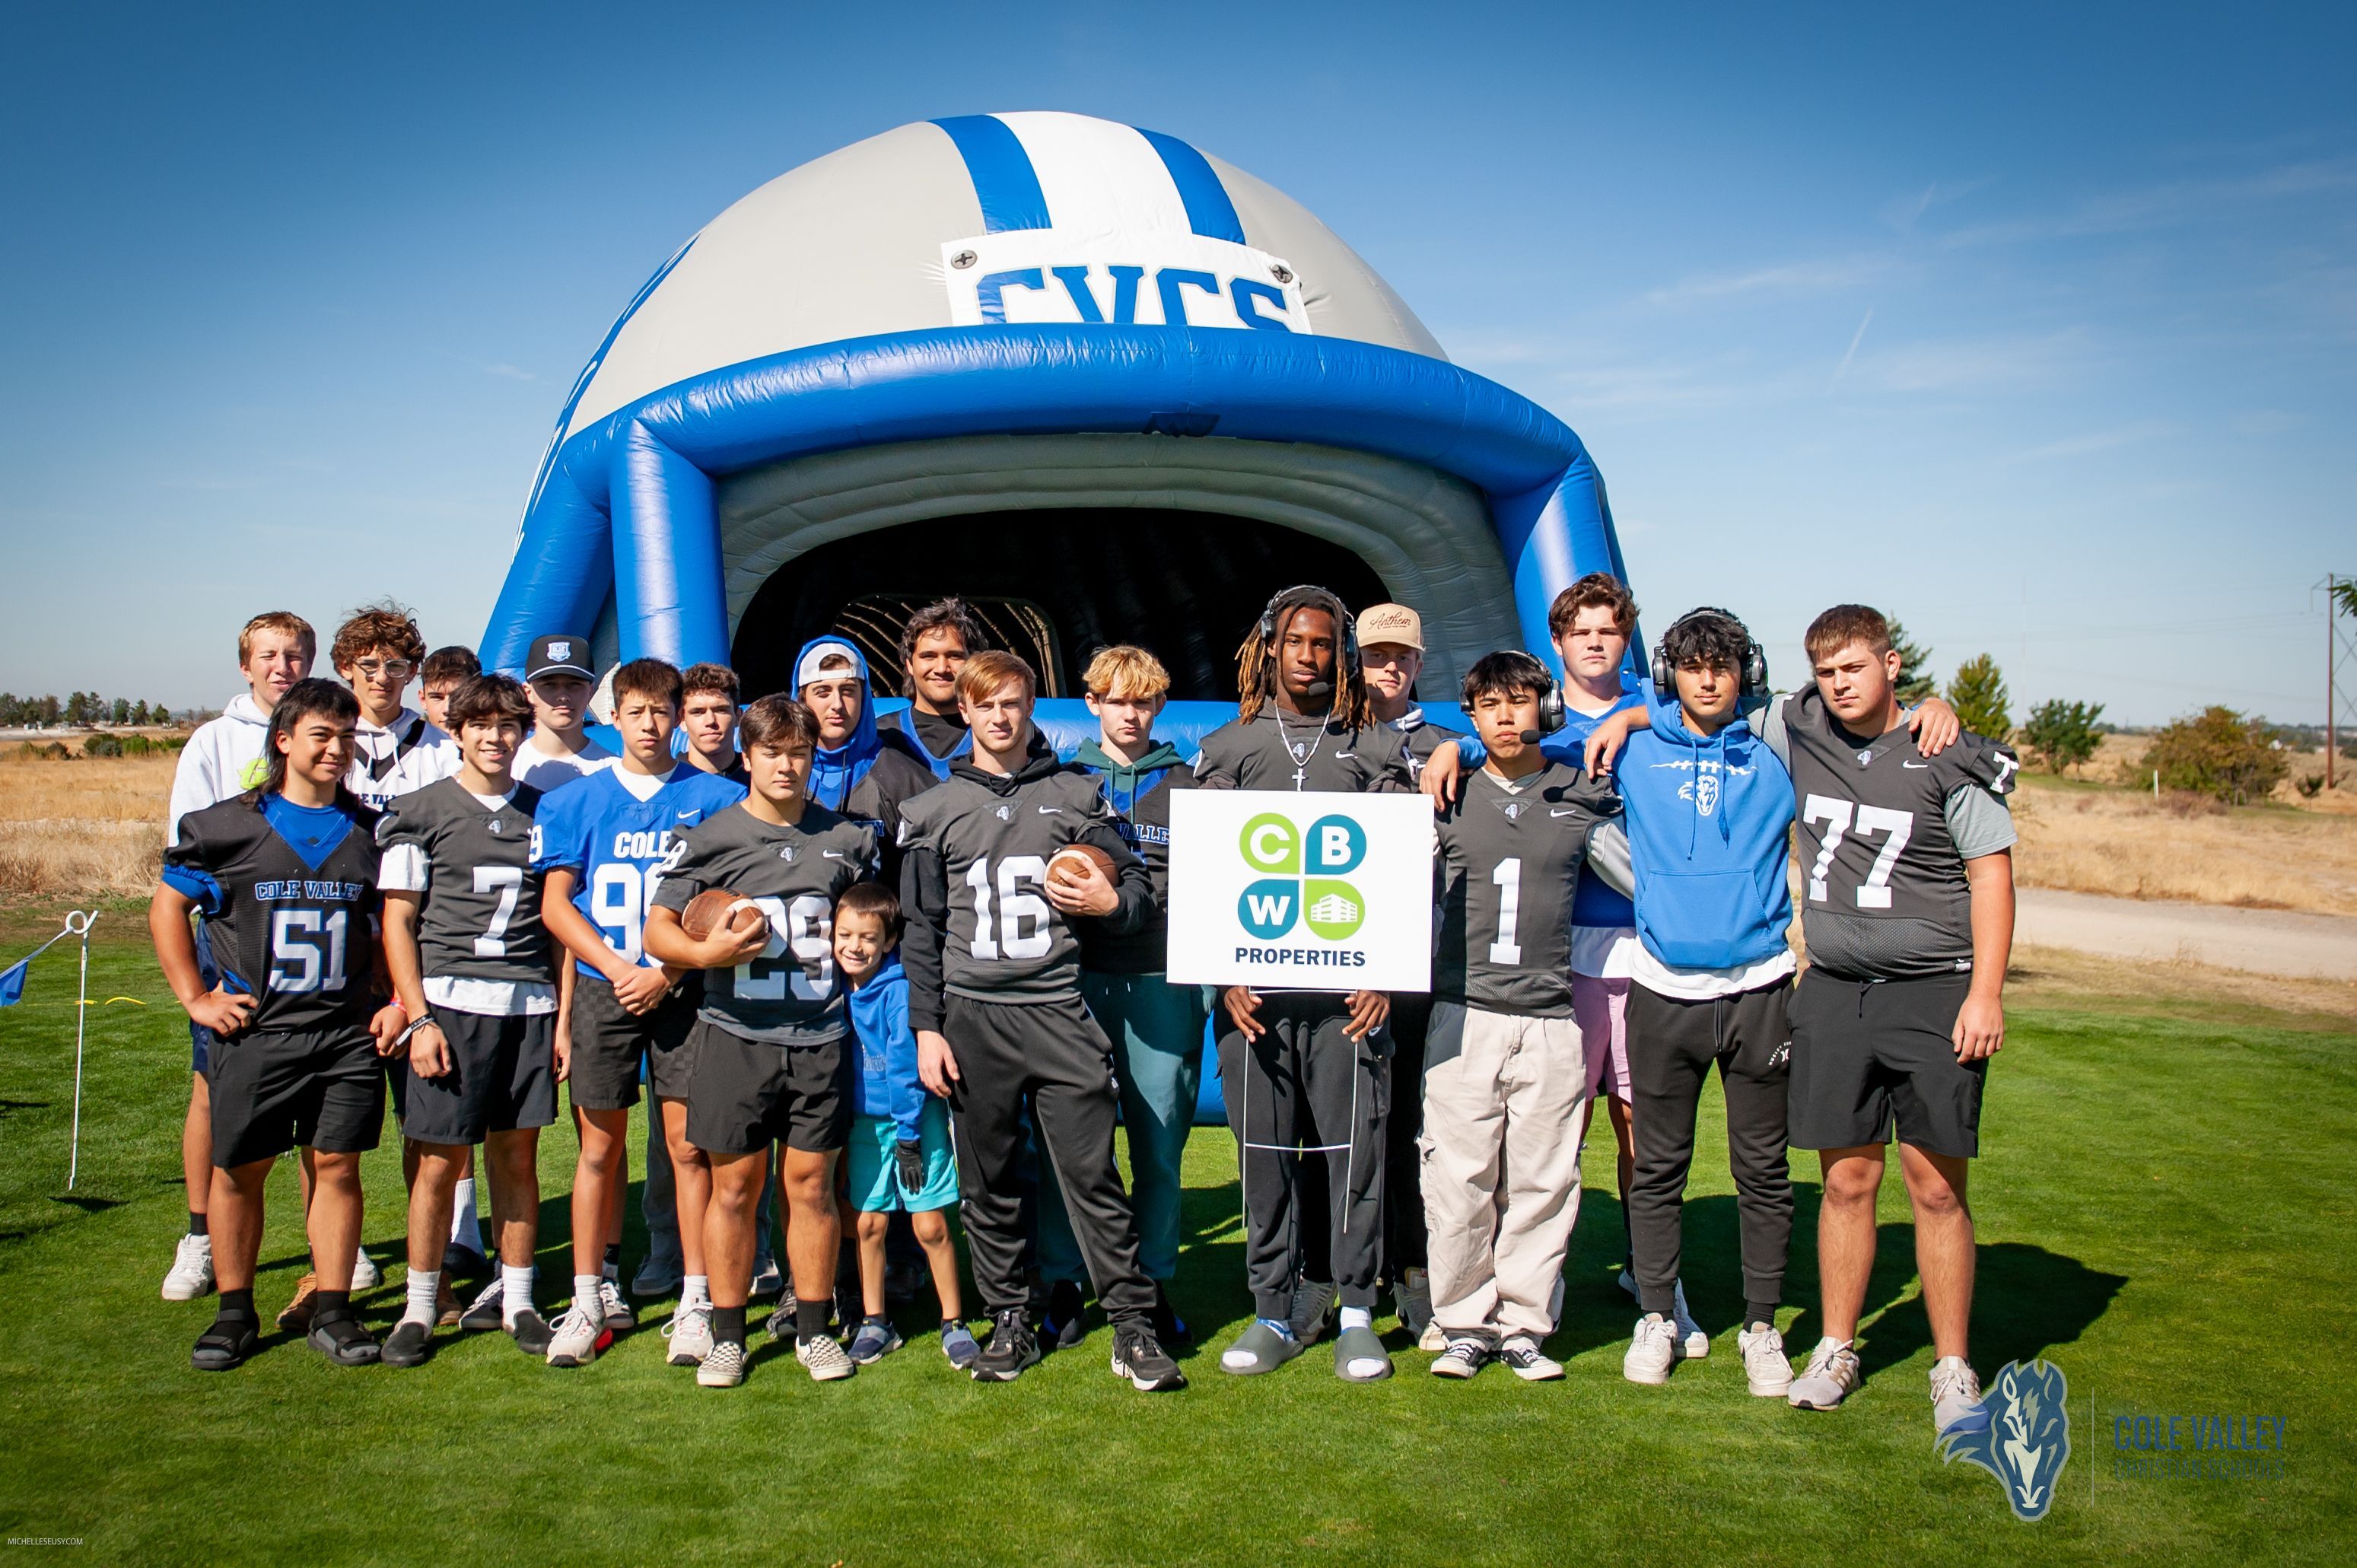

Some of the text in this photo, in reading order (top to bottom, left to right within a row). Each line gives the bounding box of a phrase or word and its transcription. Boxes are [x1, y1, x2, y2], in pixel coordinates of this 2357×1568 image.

[977, 266, 1294, 332] CVCS
[1368, 612, 1411, 630] Anthem
[1990, 751, 2019, 793] 7
[613, 830, 673, 859] COLE
[1116, 823, 1169, 845] VALLE
[1803, 794, 1913, 908] 77
[255, 880, 364, 902] COLE VALLEY
[473, 867, 523, 956] 7
[966, 856, 1052, 960] 16
[1490, 857, 1521, 965] 1
[269, 907, 348, 994] 51
[734, 895, 832, 1000] 29
[1236, 947, 1366, 967] PROPERTIES
